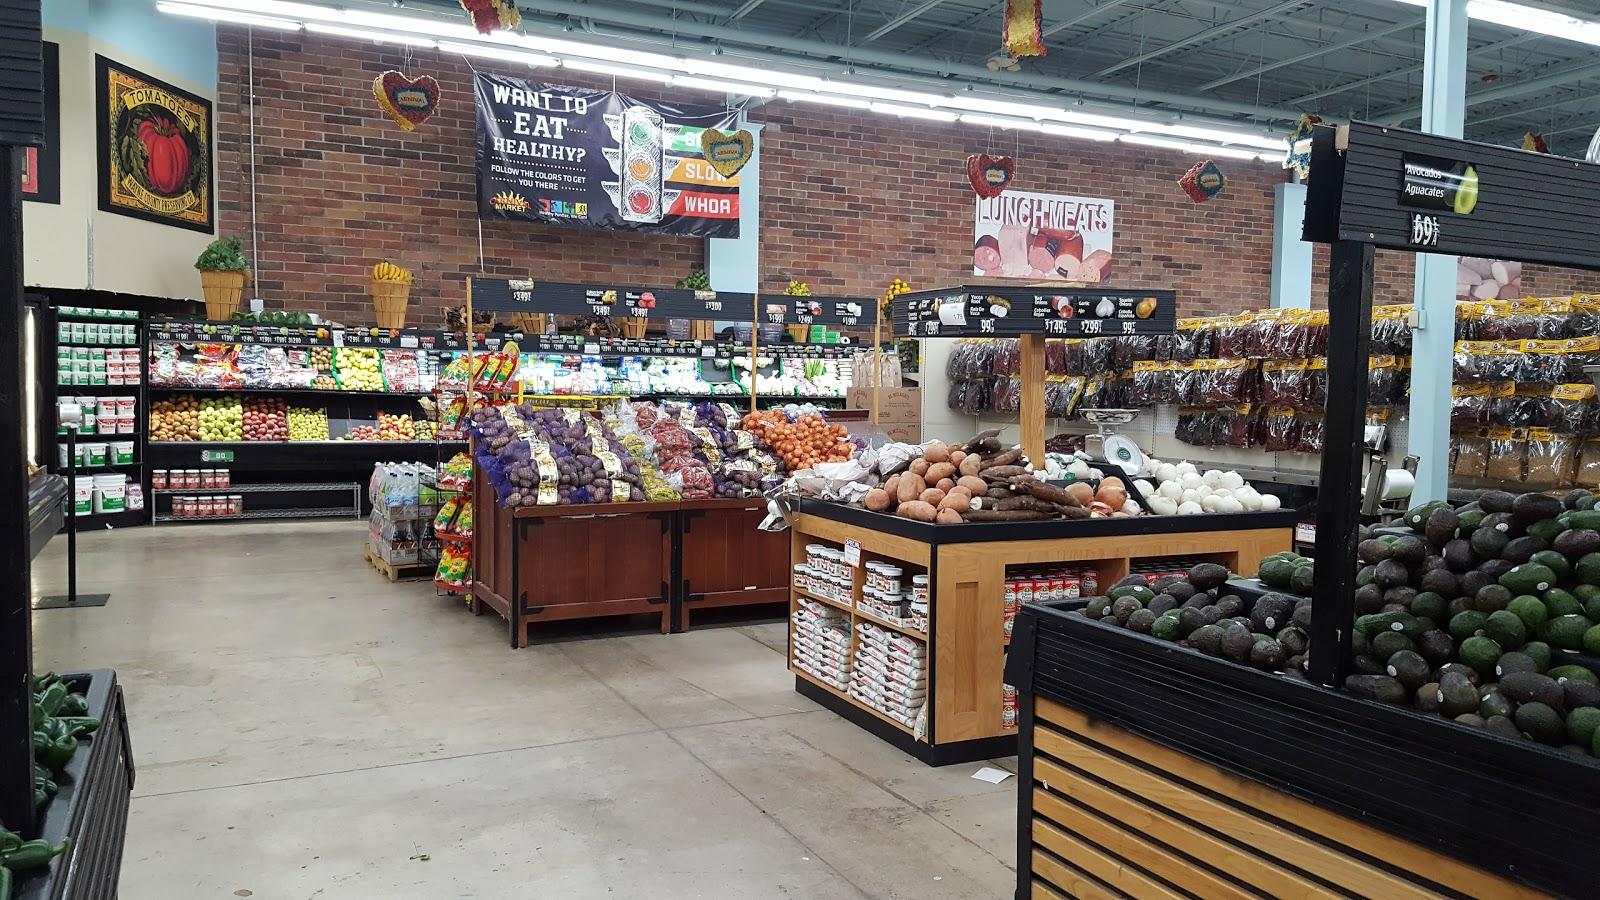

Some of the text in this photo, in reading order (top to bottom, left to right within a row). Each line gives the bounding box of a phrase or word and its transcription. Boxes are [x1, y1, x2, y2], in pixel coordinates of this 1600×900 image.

[129, 89, 191, 128] TOMATOES
[493, 84, 587, 115] WANT TO
[513, 112, 567, 140] EAT
[493, 137, 586, 163] HEALTHY?
[491, 164, 586, 184] FOLLOW THE COLORS TO GET
[1406, 164, 1442, 179] Avocados
[518, 179, 559, 190] YOU THERE
[1405, 183, 1445, 198] Aguacates
[495, 203, 526, 212] MARKET
[684, 196, 731, 214] WHOA
[979, 196, 1109, 233] LUNCH MEATS
